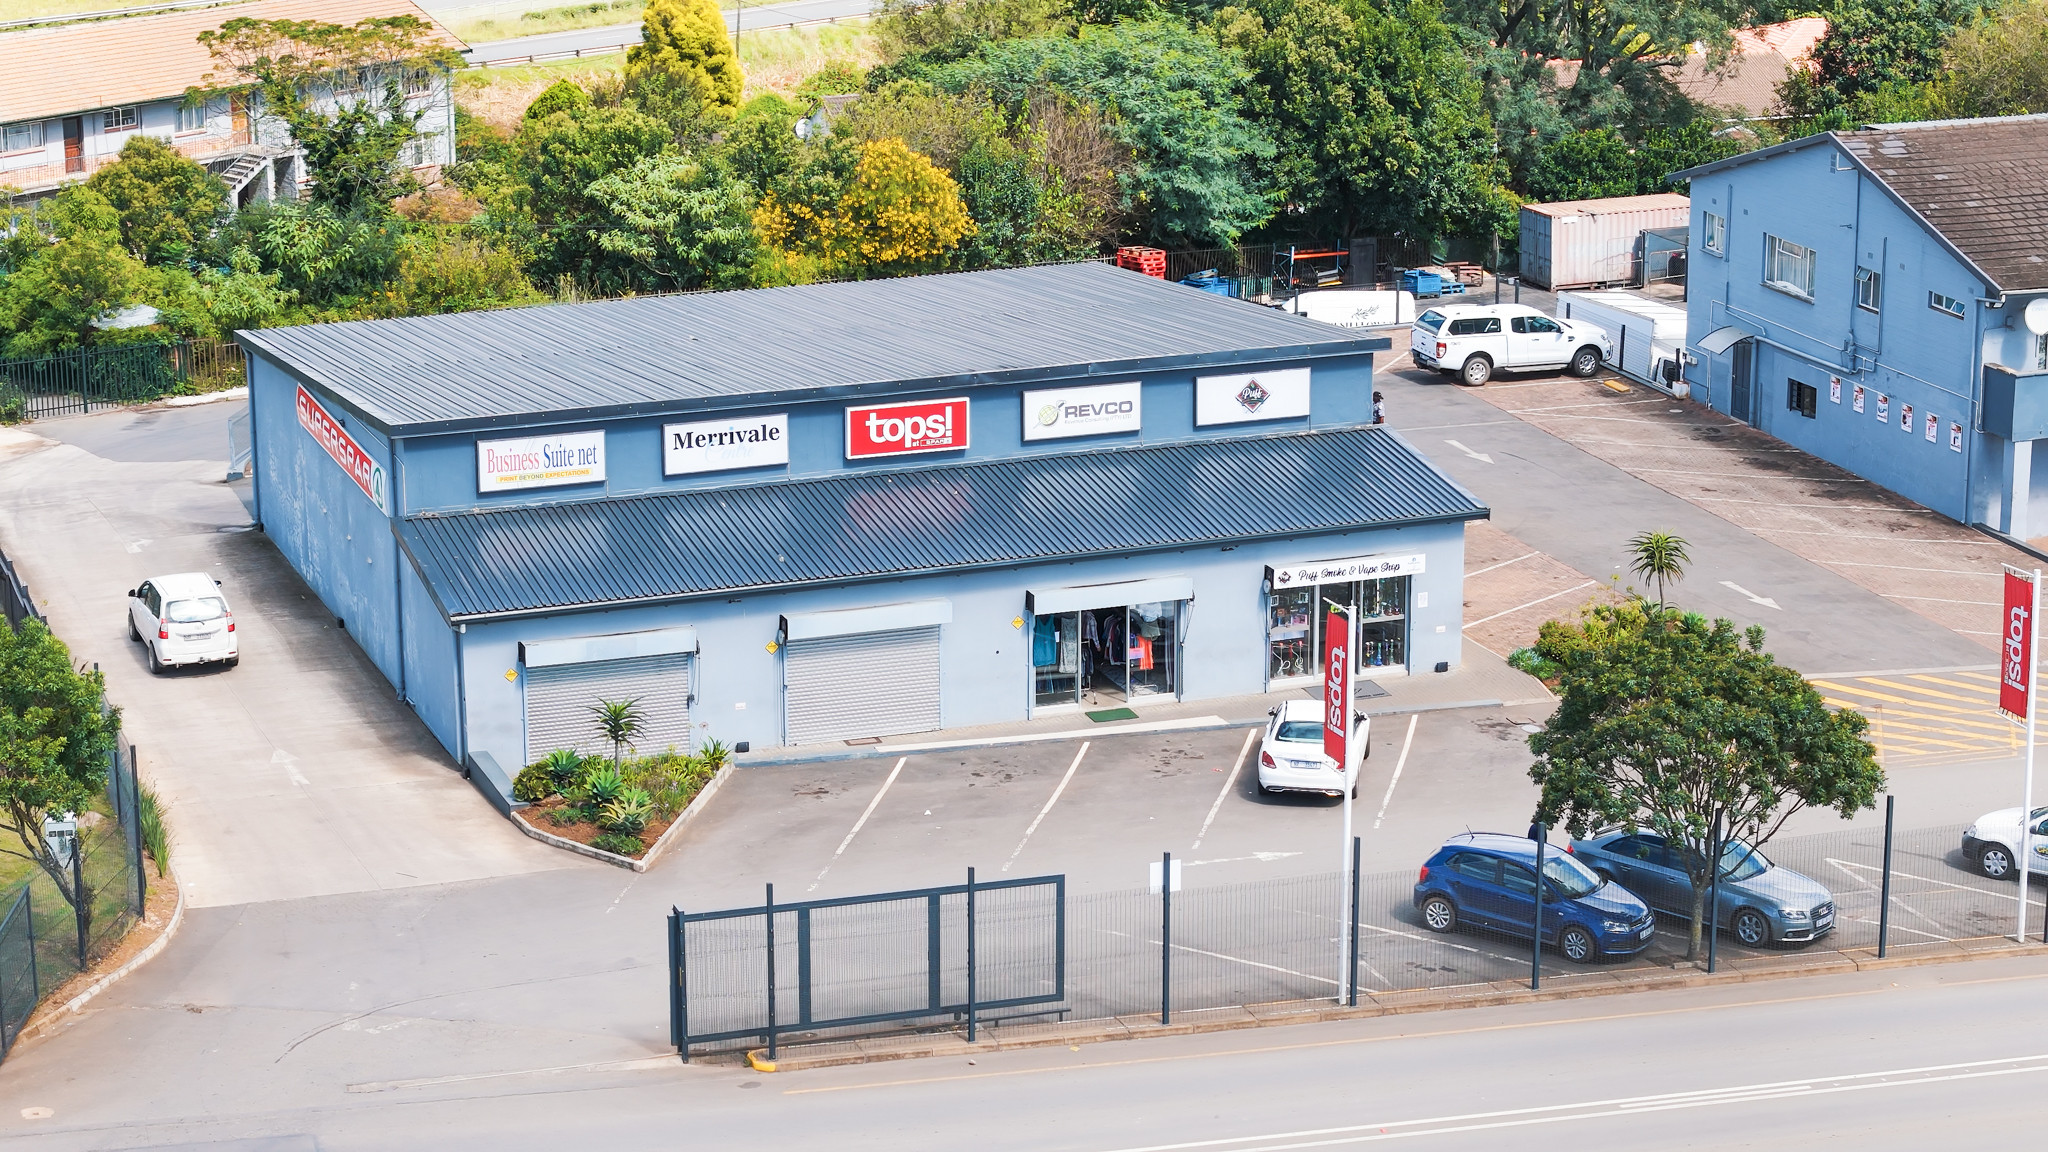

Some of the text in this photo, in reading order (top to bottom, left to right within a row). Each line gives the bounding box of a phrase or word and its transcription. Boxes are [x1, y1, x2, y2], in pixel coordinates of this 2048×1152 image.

[1064, 400, 1133, 419] REVCO
[673, 424, 780, 451] Merrivale
[865, 405, 953, 448] tops!
[299, 394, 372, 493] SUPERSPAR
[486, 443, 598, 474] Business Suite net
[545, 469, 590, 479] EXPECTATIONS
[1298, 569, 1319, 582] Puff
[1320, 567, 1347, 579] Smoke
[1358, 564, 1379, 576] Vape
[1380, 561, 1401, 573] Shop
[2005, 605, 2029, 692] tops!
[1328, 645, 1346, 738] tops!
